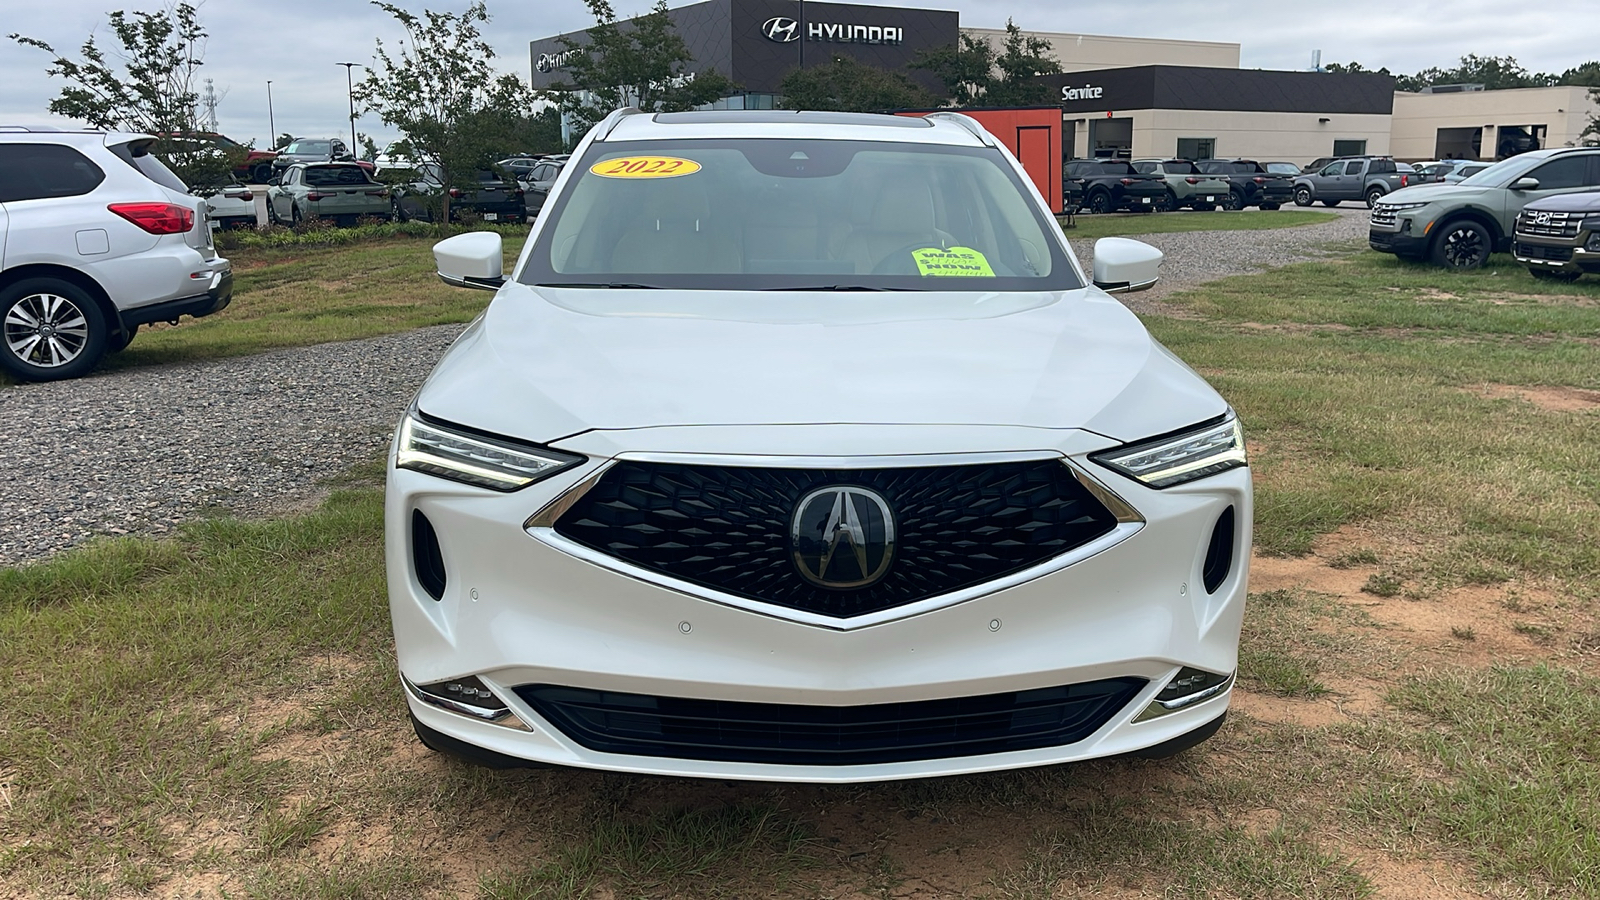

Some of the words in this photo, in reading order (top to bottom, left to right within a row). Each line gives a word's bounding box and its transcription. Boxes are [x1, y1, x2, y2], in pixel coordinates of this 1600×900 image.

[808, 22, 903, 43] HYUNDAI
[1061, 84, 1103, 100] Service
[605, 160, 684, 174] 2022
